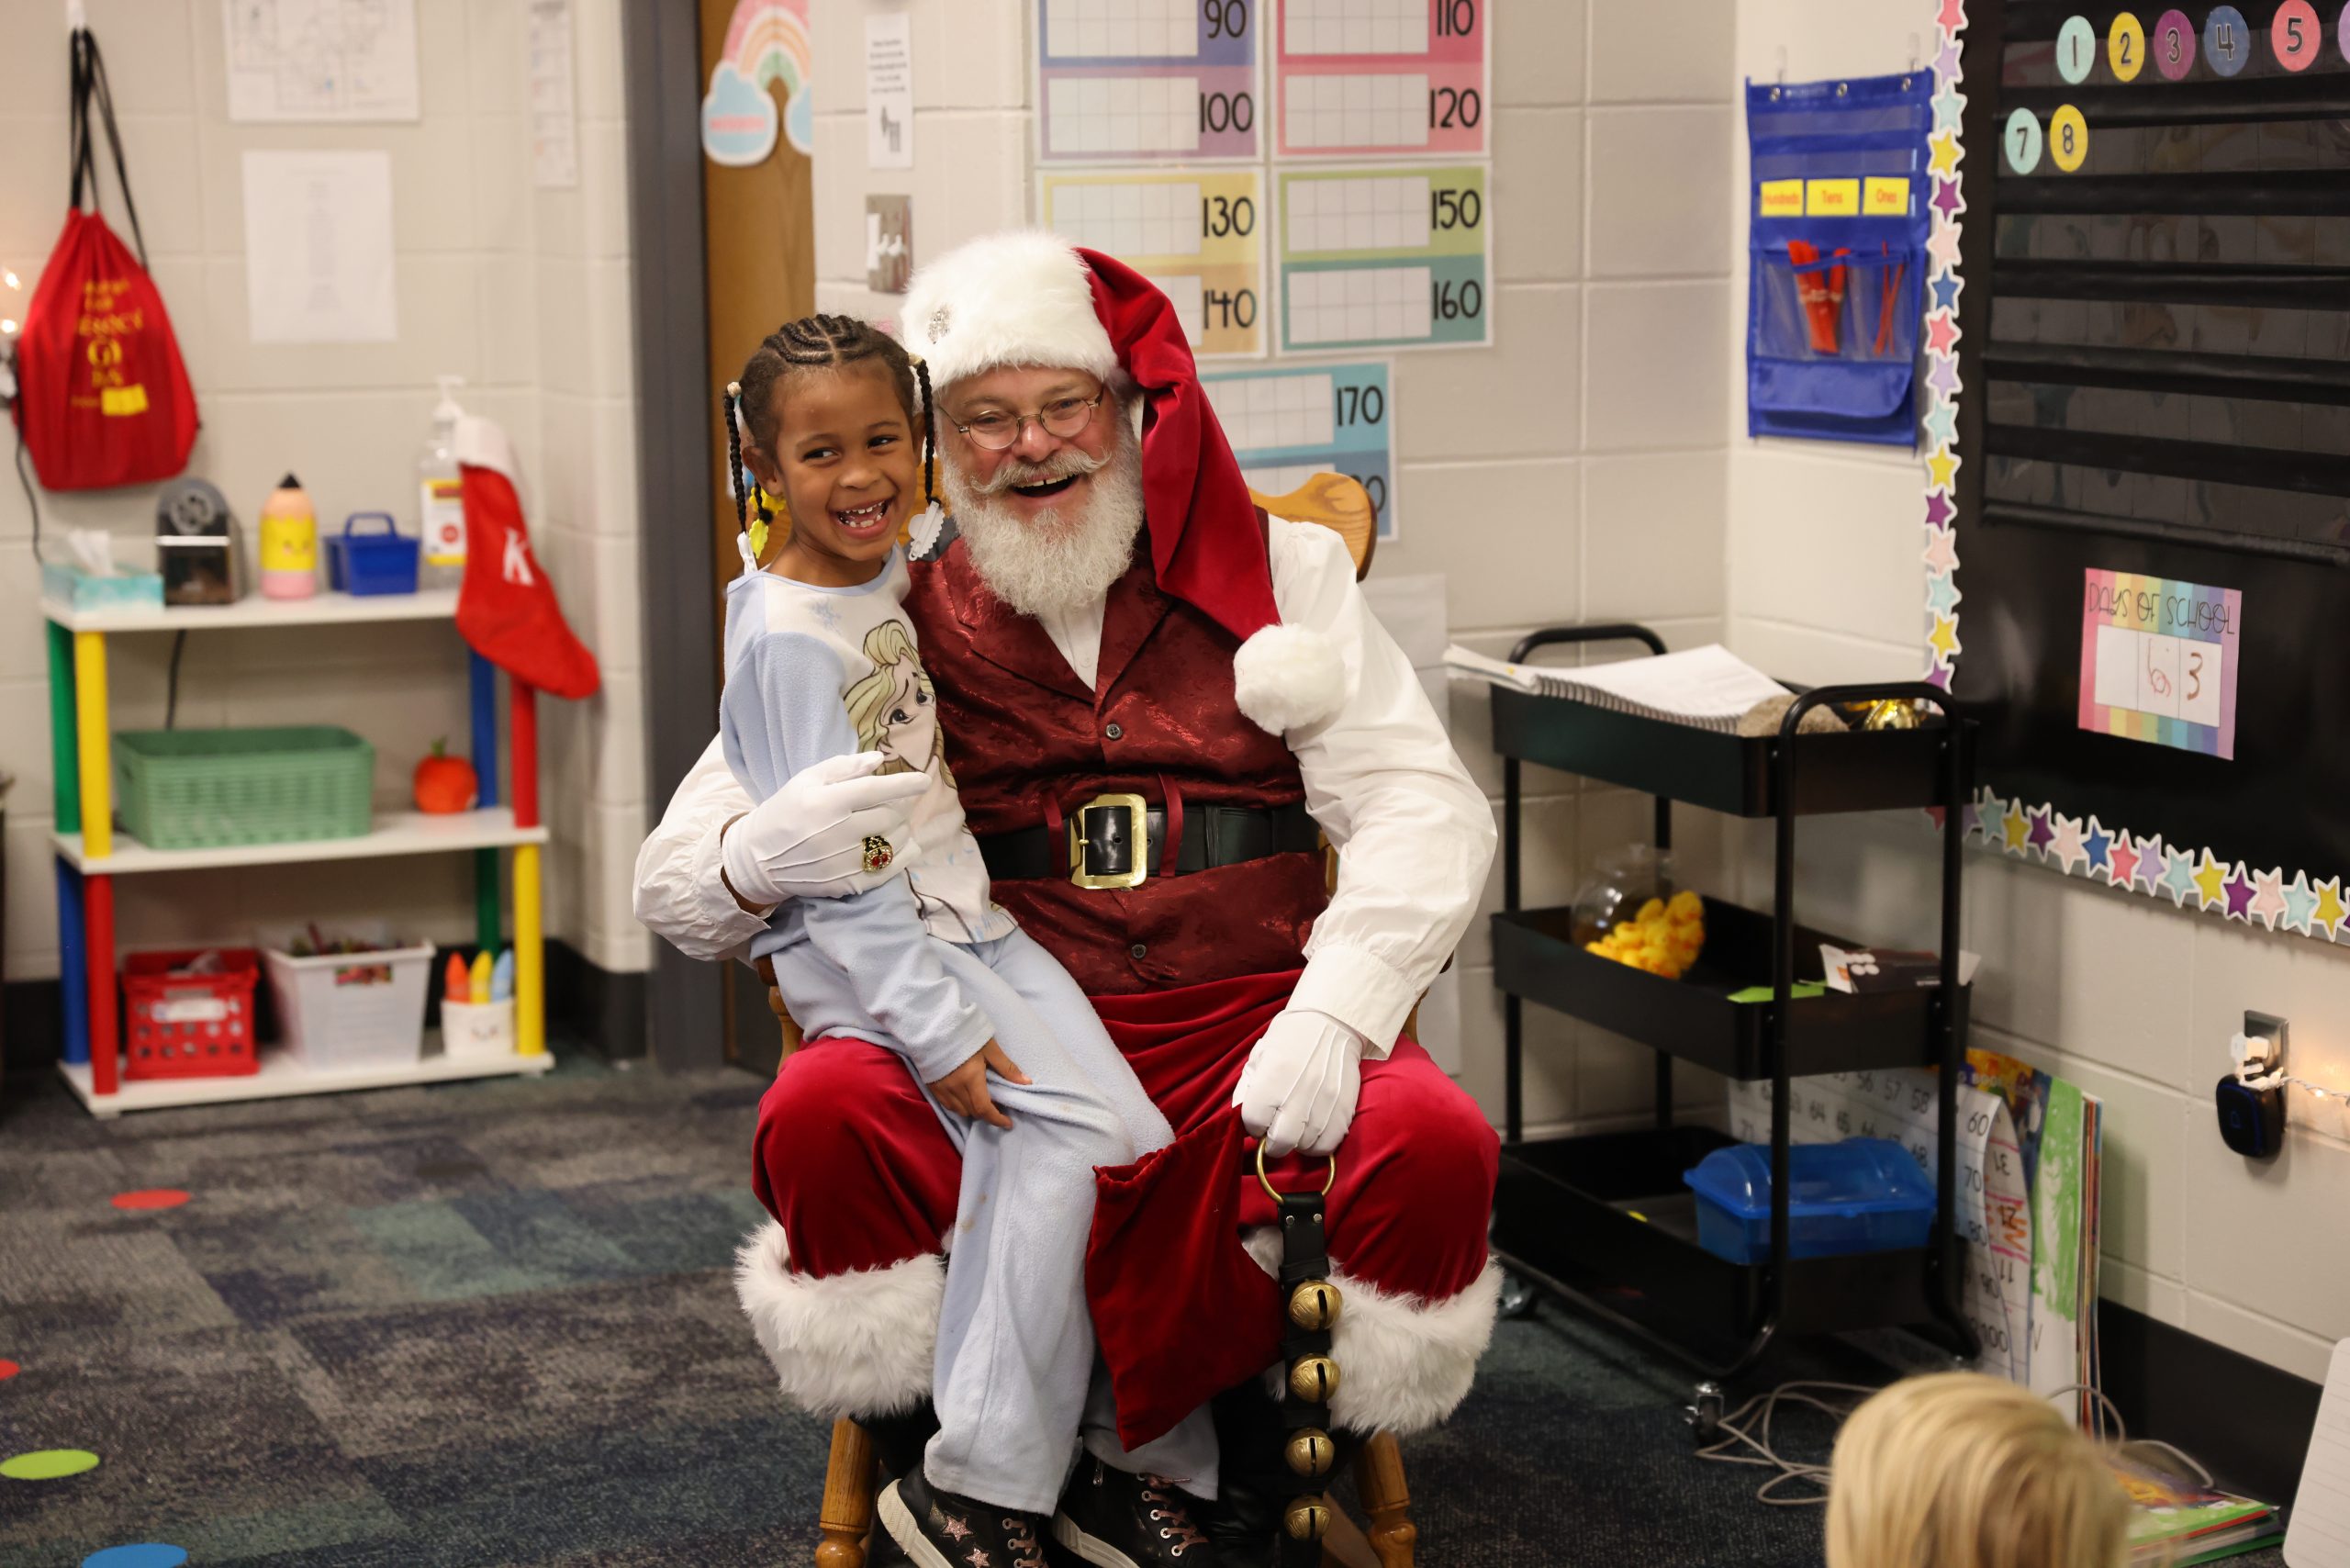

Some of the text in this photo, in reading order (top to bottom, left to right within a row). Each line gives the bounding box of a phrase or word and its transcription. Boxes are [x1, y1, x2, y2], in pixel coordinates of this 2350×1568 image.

[1204, 0, 1247, 39] 90
[1436, 0, 1474, 37] 110
[2286, 16, 2303, 53] 5
[2120, 31, 2132, 65] 2
[2165, 28, 2182, 63] 3
[2215, 23, 2235, 61] 4
[1200, 92, 1254, 133] 100
[1429, 87, 1481, 129] 120
[2016, 126, 2029, 160] 7
[2062, 122, 2075, 155] 8
[1431, 188, 1481, 230] 150
[1821, 189, 1844, 205] Tens
[1875, 188, 1897, 204] Ones
[1203, 196, 1255, 238] 130
[1203, 289, 1257, 330] 140
[1433, 280, 1482, 319] 160
[1337, 386, 1383, 427] 170
[501, 526, 535, 587] K
[2088, 582, 2235, 634] DAYS OF SCHOOL
[1967, 1112, 1989, 1137] 60
[1964, 1165, 1983, 1193] 70
